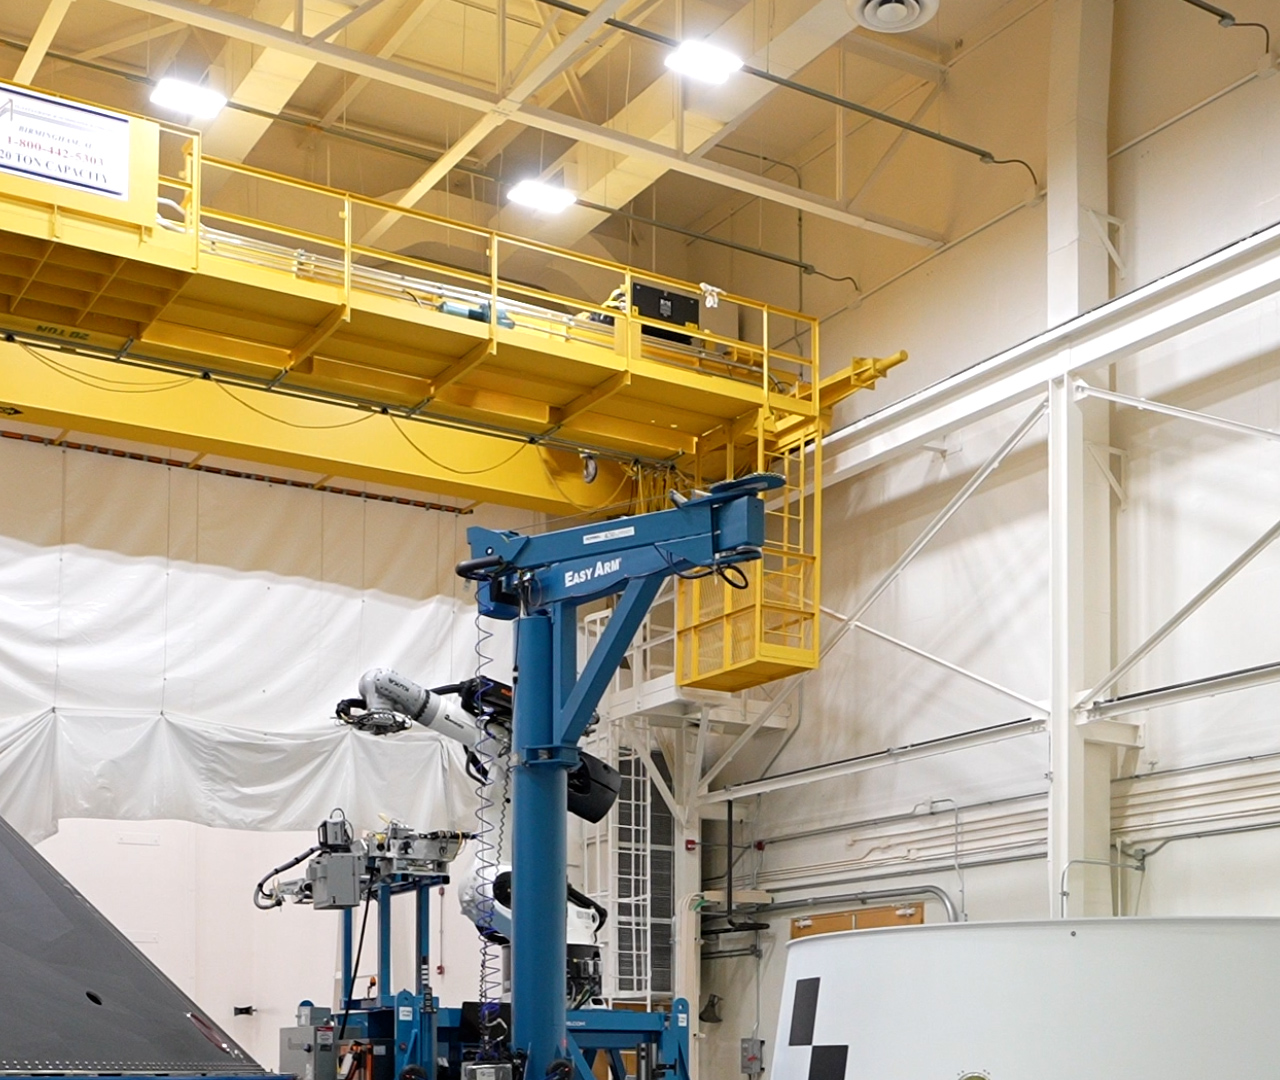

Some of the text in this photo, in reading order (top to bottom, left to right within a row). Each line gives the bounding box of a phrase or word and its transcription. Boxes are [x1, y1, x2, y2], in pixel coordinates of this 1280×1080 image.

[0, 148, 108, 184] 20 TON CAPACITY
[564, 567, 593, 588] EASY
